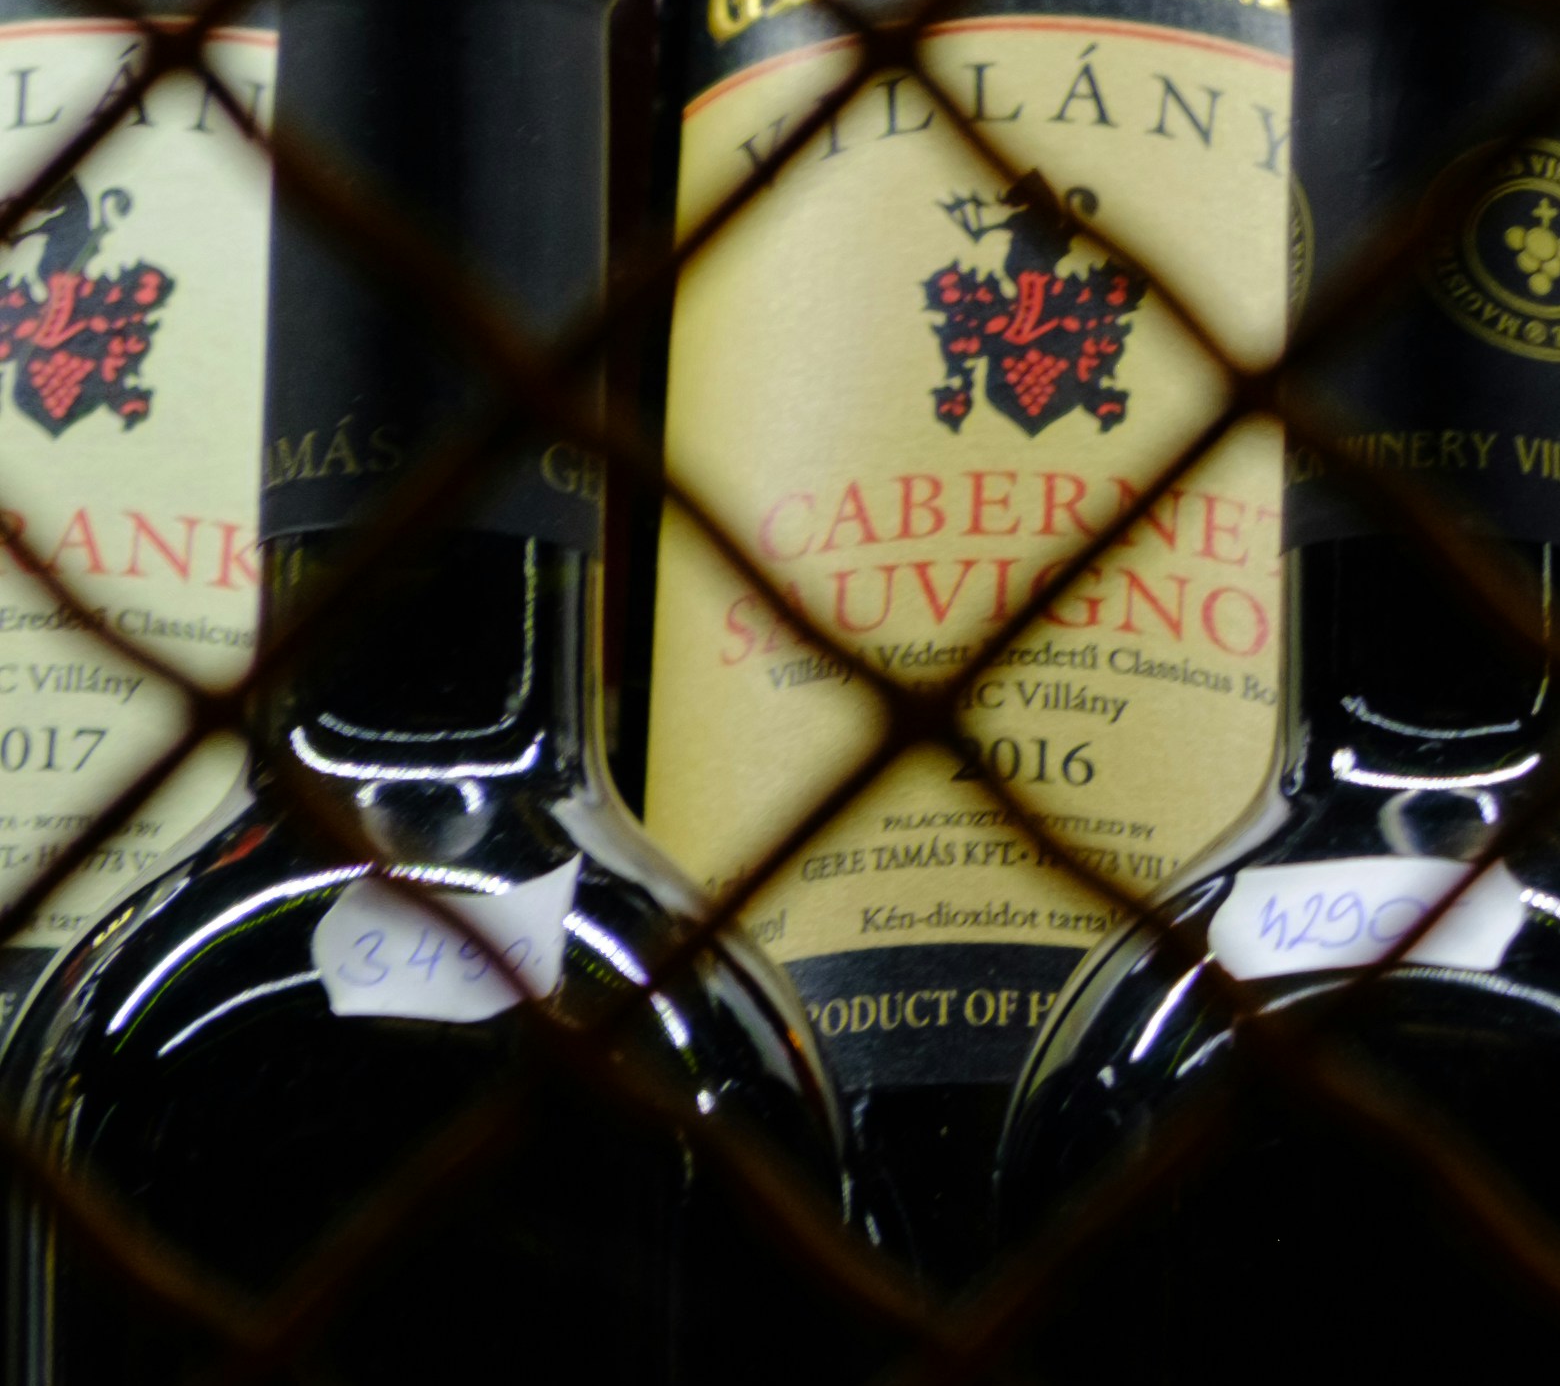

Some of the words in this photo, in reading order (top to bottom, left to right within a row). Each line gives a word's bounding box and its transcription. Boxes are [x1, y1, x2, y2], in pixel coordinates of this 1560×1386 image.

[27, 661, 146, 707] Villány
[1016, 679, 1131, 725] Villány
[949, 736, 1097, 787] 2016
